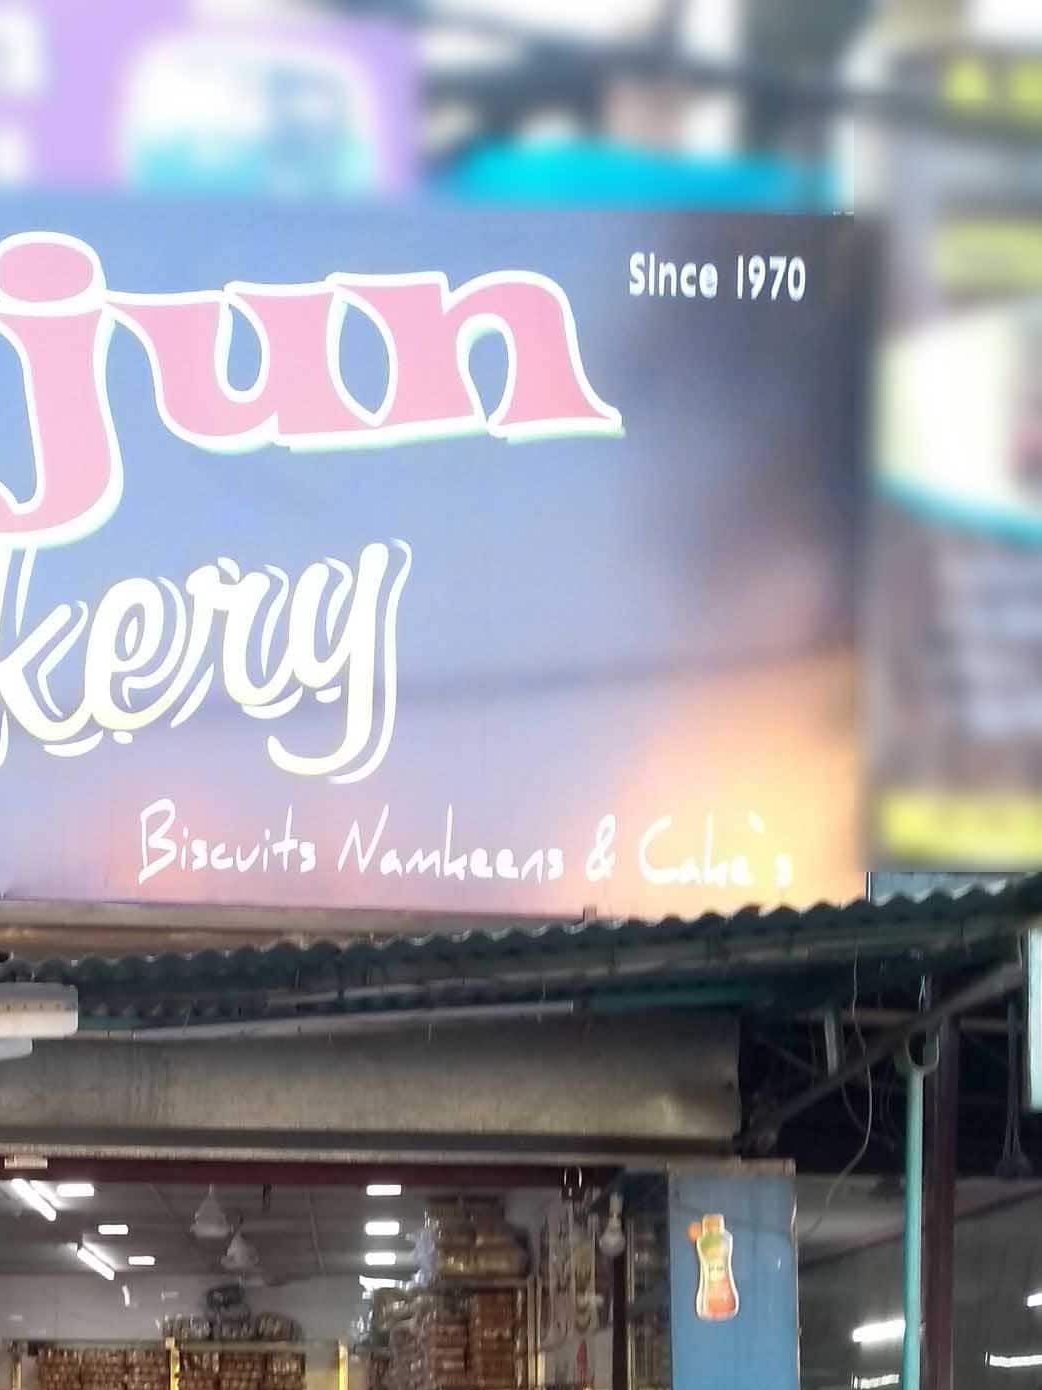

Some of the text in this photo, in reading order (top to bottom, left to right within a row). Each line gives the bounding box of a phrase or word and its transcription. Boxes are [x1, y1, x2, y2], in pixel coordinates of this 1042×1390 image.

[737, 255, 806, 301] 1970
[138, 798, 316, 884] Biscuits
[337, 804, 564, 884] Namkeens
[585, 813, 616, 881] &
